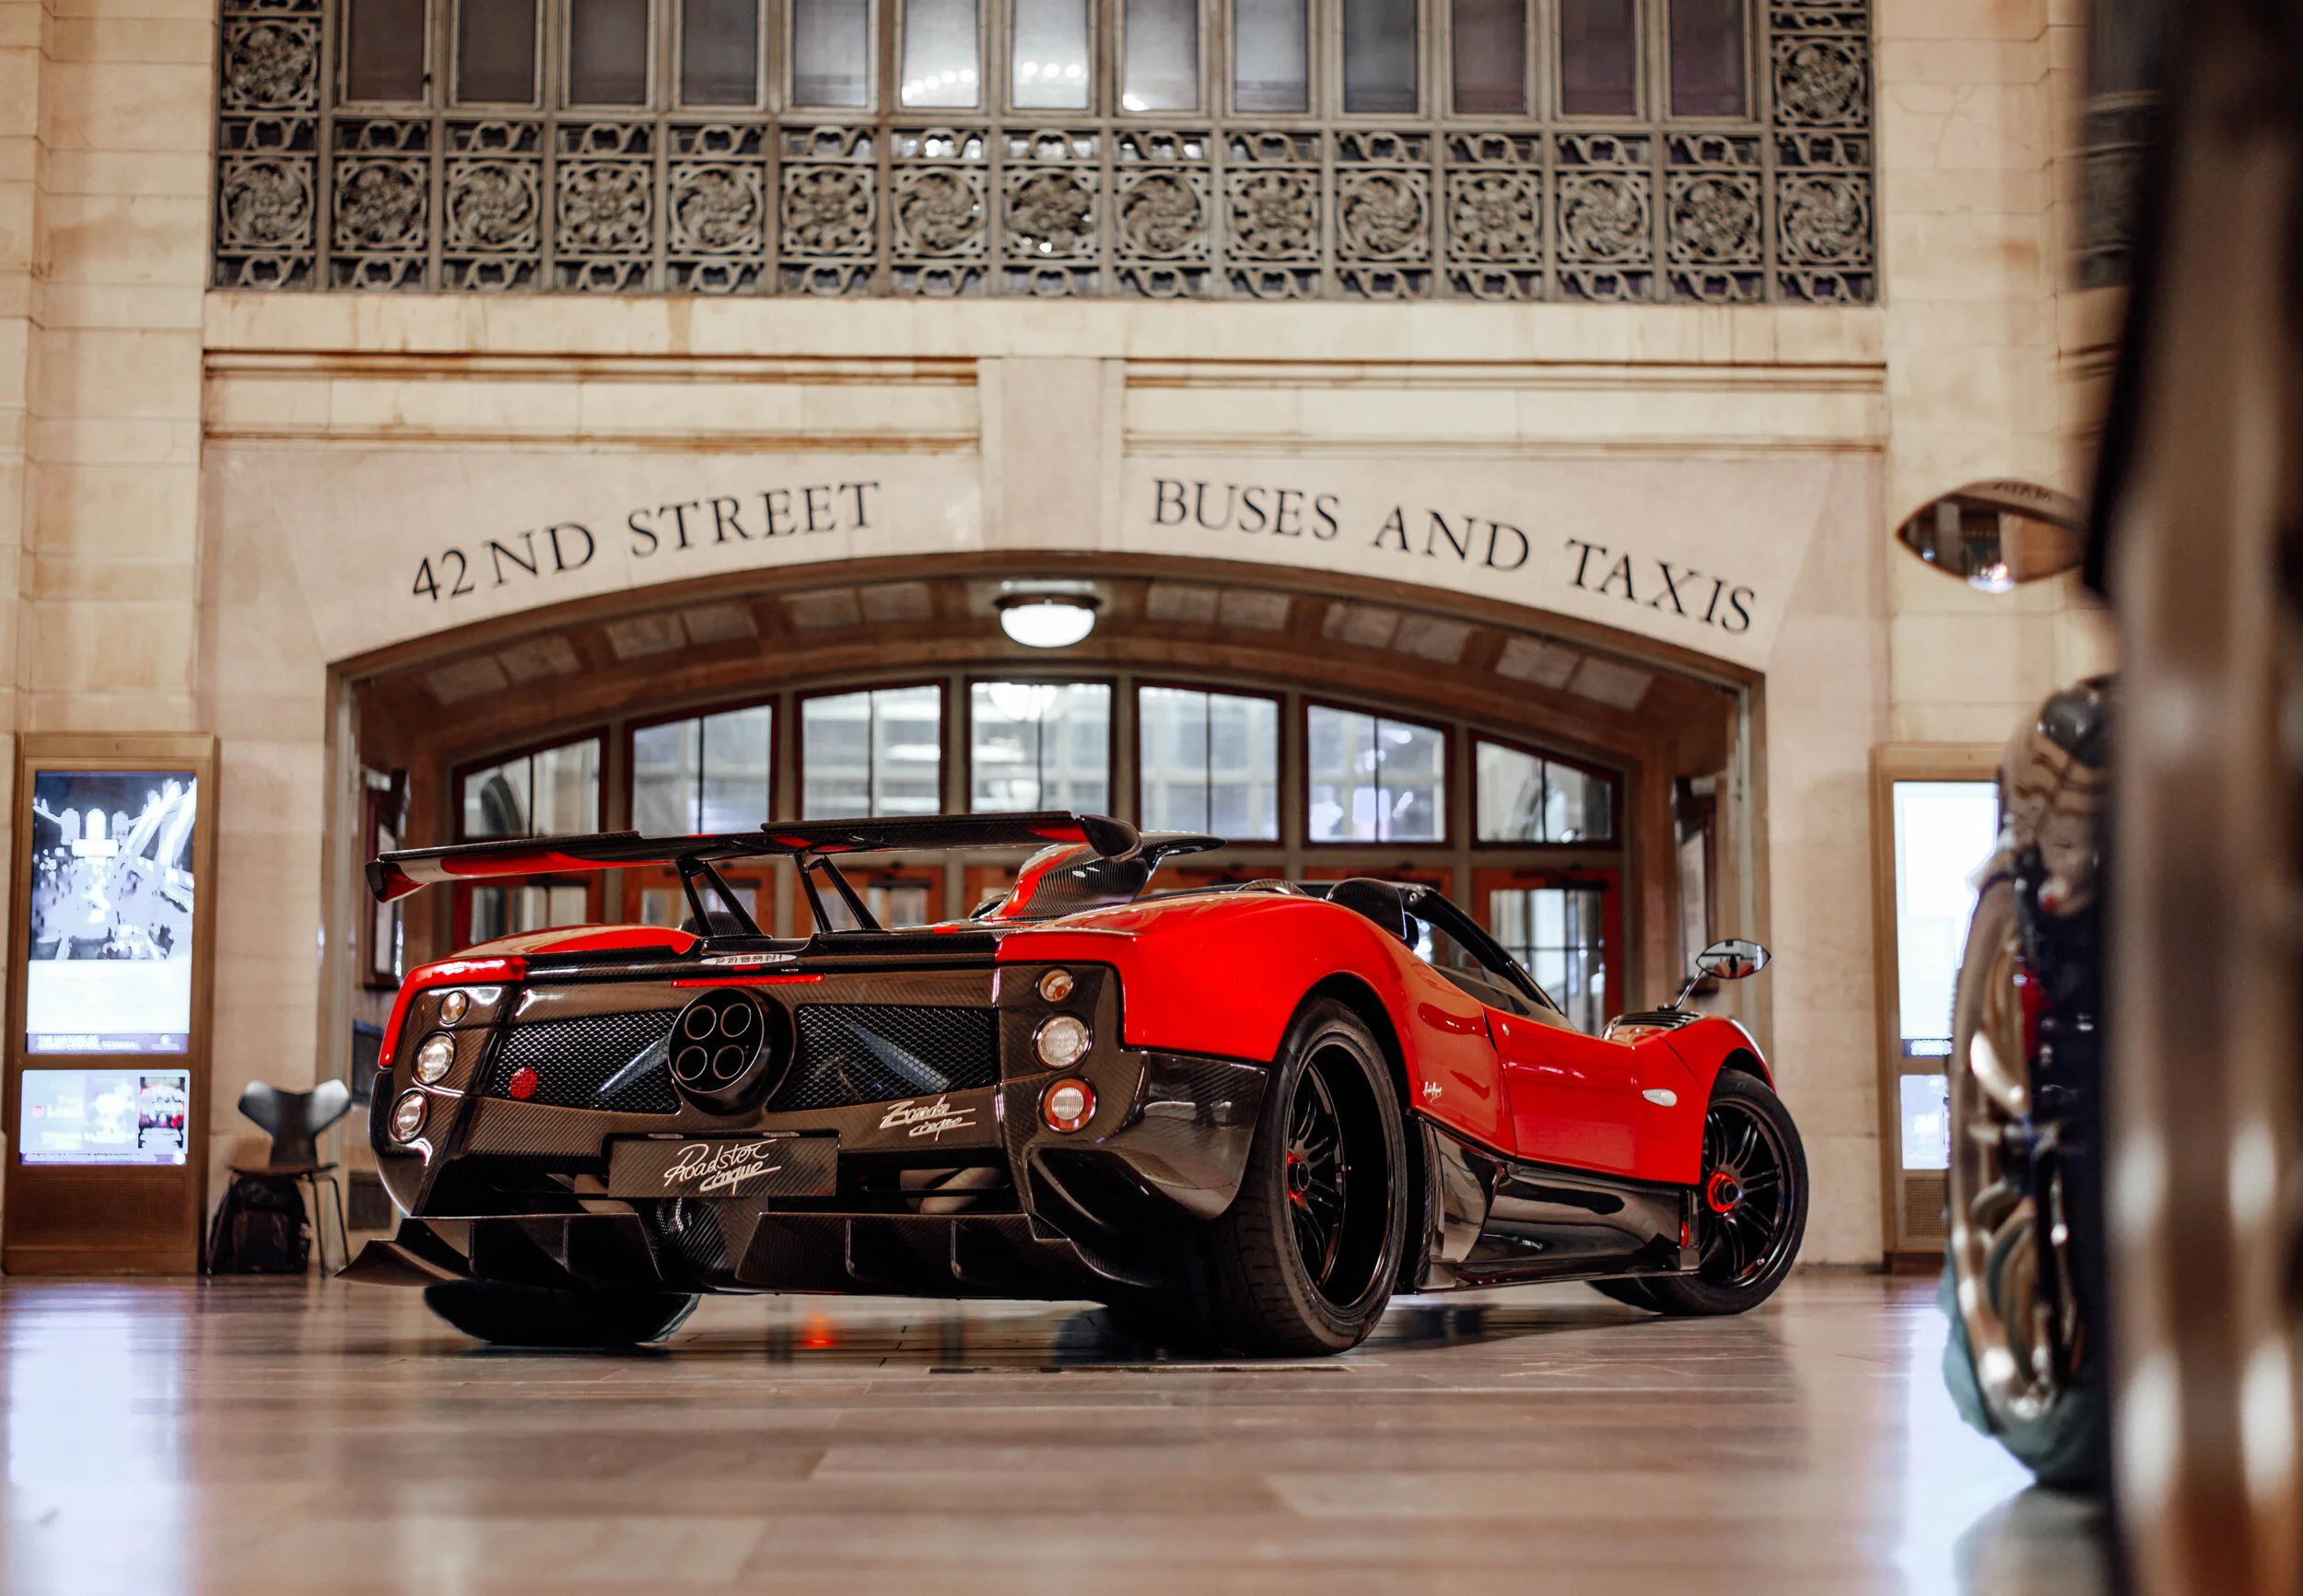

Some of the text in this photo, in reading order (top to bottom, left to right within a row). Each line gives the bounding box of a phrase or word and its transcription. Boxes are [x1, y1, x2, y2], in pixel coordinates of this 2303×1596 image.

[412, 482, 880, 601] 42ND STREET
[1151, 478, 1756, 635] BUSES AND TAXIS
[714, 954, 782, 964] PAGANI
[663, 1138, 777, 1187] Roadster
